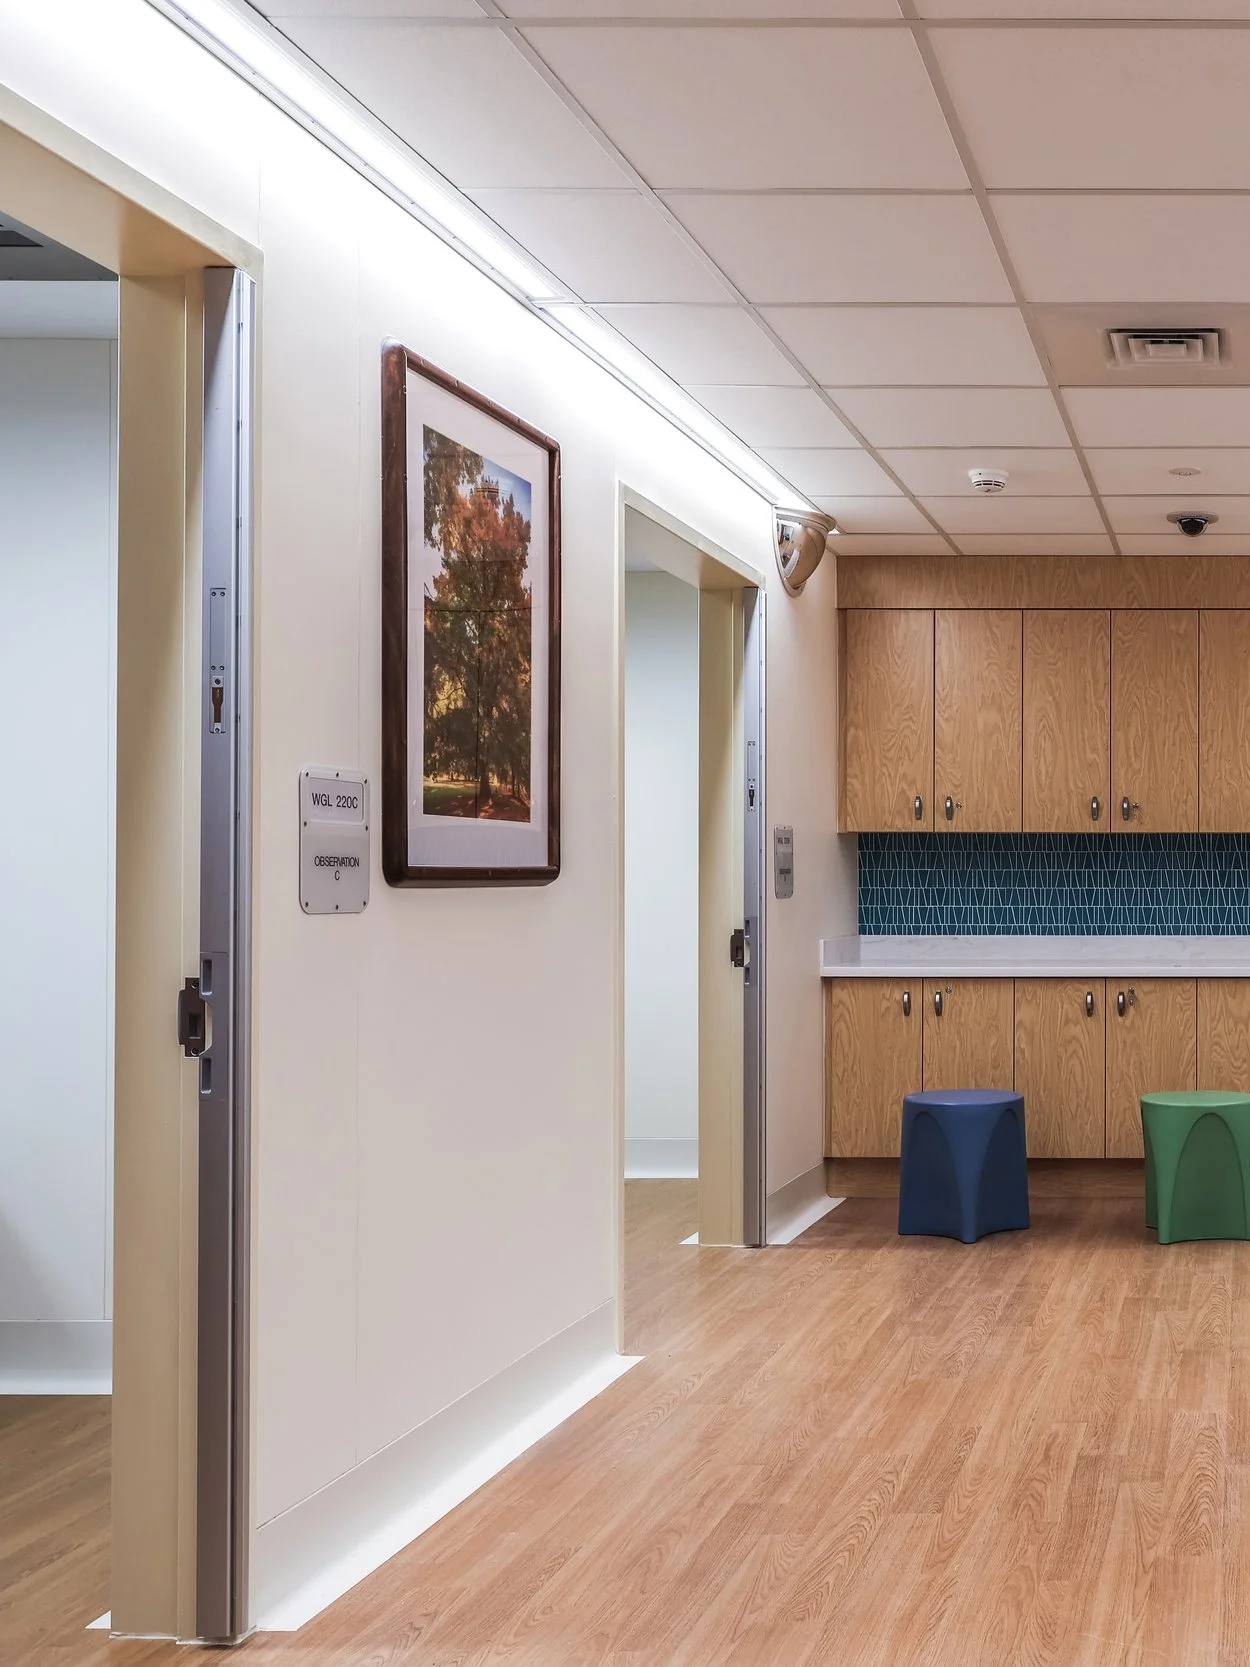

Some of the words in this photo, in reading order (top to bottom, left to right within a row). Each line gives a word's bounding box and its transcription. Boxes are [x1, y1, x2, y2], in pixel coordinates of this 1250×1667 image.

[311, 792, 333, 807] WGL
[336, 795, 359, 809] 220C
[314, 855, 360, 867] OBSERVATION
[334, 870, 341, 881] C
